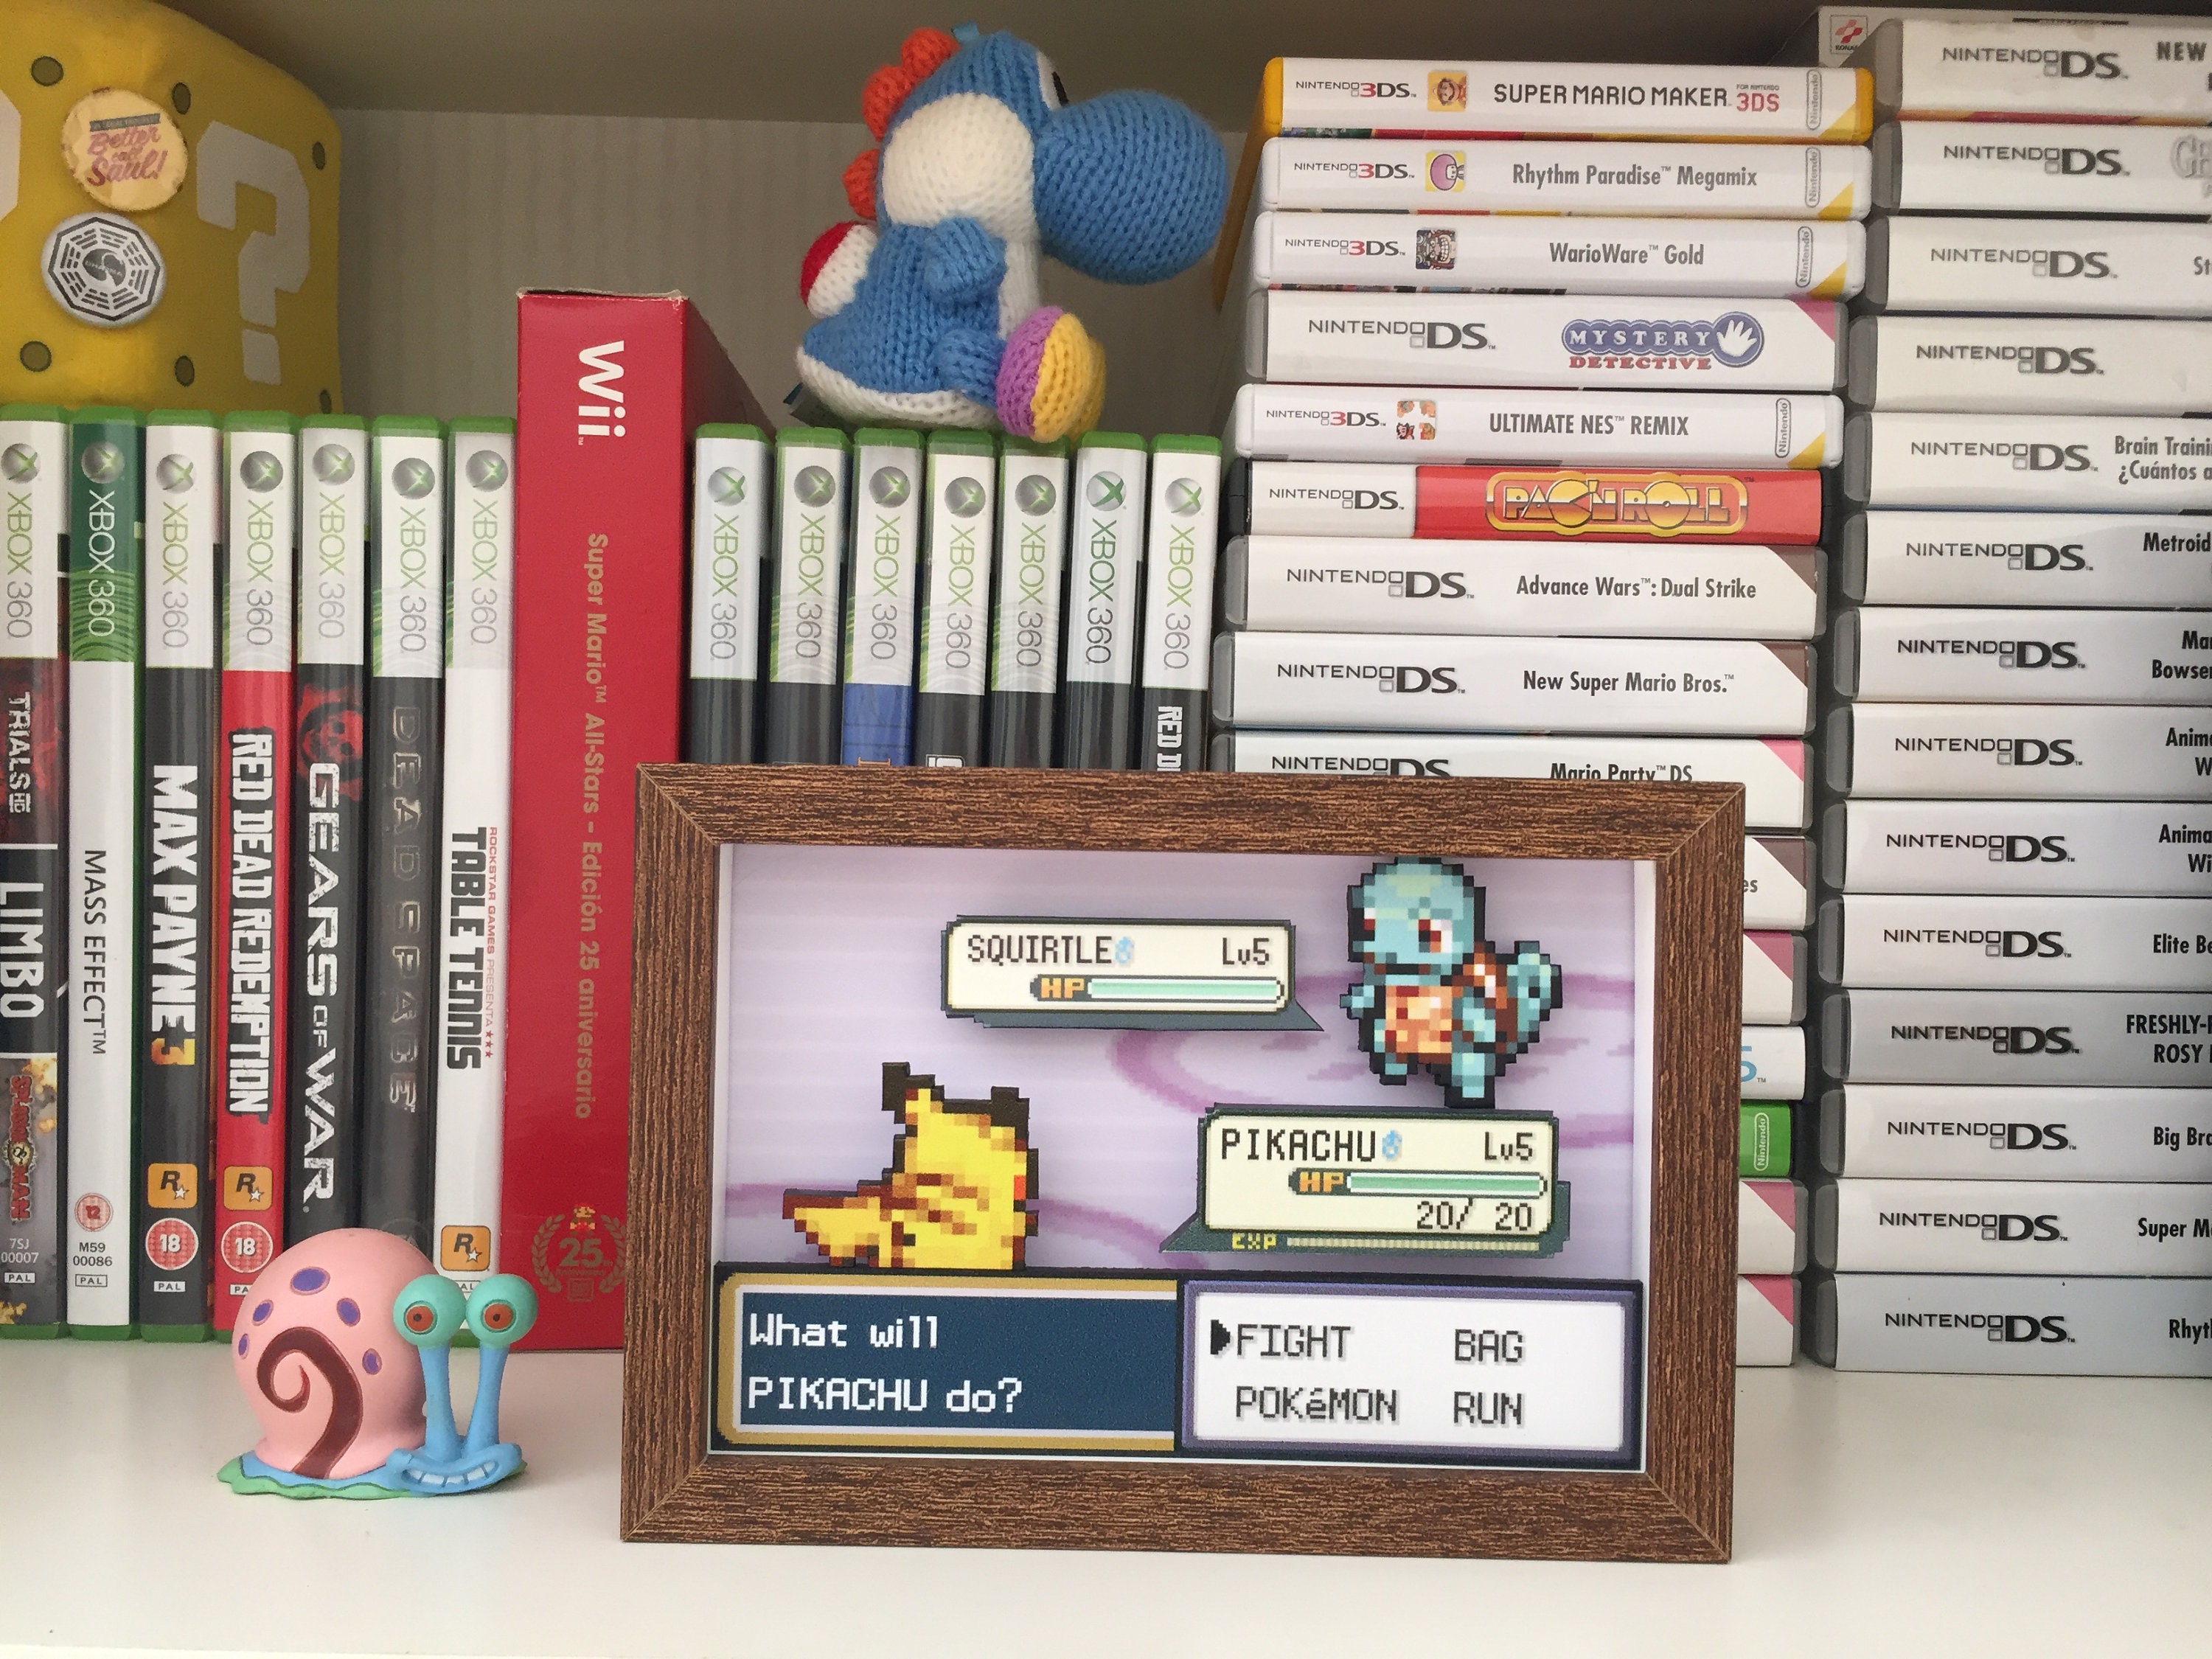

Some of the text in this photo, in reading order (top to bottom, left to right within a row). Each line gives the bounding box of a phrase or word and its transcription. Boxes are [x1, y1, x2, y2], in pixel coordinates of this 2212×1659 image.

[2157, 41, 2207, 61] NEW
[1495, 84, 1567, 103] SUPER
[1573, 86, 1645, 105] MARIO
[1736, 92, 1780, 112] 3DS
[87, 149, 168, 187] Saul!
[1513, 164, 1579, 190] Rhythm
[1677, 166, 1757, 191] Megamix
[1809, 151, 1818, 202] Nintendo
[1665, 244, 1704, 265] Gold
[1799, 230, 1809, 282] Nintendo
[1309, 320, 1425, 334] NINTENDO
[1569, 330, 1710, 346] MYSTERY
[1569, 356, 1711, 369] DETECTIVE
[1489, 414, 1573, 434] ULTIMATE
[1631, 416, 1688, 435] REMIX
[1779, 402, 1788, 453] Nintendo
[2115, 435, 2158, 455] Brain
[2118, 459, 2197, 485] ¿Cuántos
[1269, 489, 1354, 499] NINTENDO
[1621, 481, 1730, 529] ROLL
[2143, 532, 2211, 552] Metroid
[88, 490, 115, 637] XBOX 360
[246, 499, 274, 646] XBOX 360
[584, 533, 608, 604] Super
[1287, 569, 1404, 583] NINTENDO
[400, 507, 426, 652] XBOX 360
[795, 513, 825, 658] XBOX 360
[1517, 574, 1589, 596] Advance
[1661, 577, 1699, 597] Dual
[1705, 578, 1756, 599] Strike
[945, 524, 975, 669] XBOX 360
[1164, 524, 1195, 669] XBOX 360
[2182, 630, 2212, 650] Ma
[1278, 664, 1394, 678] NINTENDO
[1523, 670, 1563, 690] New
[1571, 671, 1619, 696] Super
[1625, 673, 1677, 692] Mario
[1157, 706, 1183, 748] RED
[8, 692, 31, 790] TRIALS
[584, 713, 605, 824] All-Stars
[1272, 756, 1388, 771] NINTENDO
[1550, 762, 1601, 779] Mario
[1670, 765, 1693, 782] DS
[392, 706, 422, 882] DEAD
[1886, 834, 2005, 848] NINTENDO
[84, 851, 107, 925] MASS
[580, 842, 603, 933] Edición
[151, 765, 198, 1065] MAX PAYNE 3
[229, 734, 273, 1112] RED DEAD REDEMPTION
[484, 827, 498, 1028] ROCKSTAR GAMES PRESENTA
[0, 883, 44, 1018] LIMBO
[446, 827, 487, 1070] TABLE TENNIS
[579, 940, 600, 971] 25
[967, 934, 1270, 967] SQUIRTLE Lv5
[2153, 933, 2190, 953] Elite
[303, 762, 340, 1204] GEARS OF WAR
[1040, 977, 1085, 999] HP
[575, 978, 599, 1119] aniversario
[2154, 1043, 2203, 1063] ROSY
[1222, 1129, 1534, 1161] PIKACHU Lv5
[1756, 1118, 1767, 1166] Nintendo
[2154, 1126, 2180, 1151] Big
[1299, 1172, 1344, 1193] HP
[1416, 1197, 1532, 1231] 20/ 20
[1879, 1212, 1997, 1227] NINTENDO
[1232, 1234, 1277, 1251] EXP
[2138, 1217, 2187, 1242] Super
[10, 1238, 29, 1251] 7SJ
[79, 1242, 105, 1252] M59
[159, 1234, 180, 1253] 18
[235, 1237, 256, 1256] 18
[559, 1237, 604, 1267] 25
[1, 1252, 39, 1263] 00007
[73, 1256, 113, 1267] 00086
[8, 1274, 32, 1282] PAL
[80, 1277, 102, 1285] PAL
[749, 1313, 938, 1349] What will
[1237, 1324, 1523, 1363] FIGHT BAG
[2169, 1318, 2212, 1344] Rhyt
[748, 1376, 1023, 1413] PIKACHU do?
[1236, 1386, 1522, 1425] POKéMON RUN
